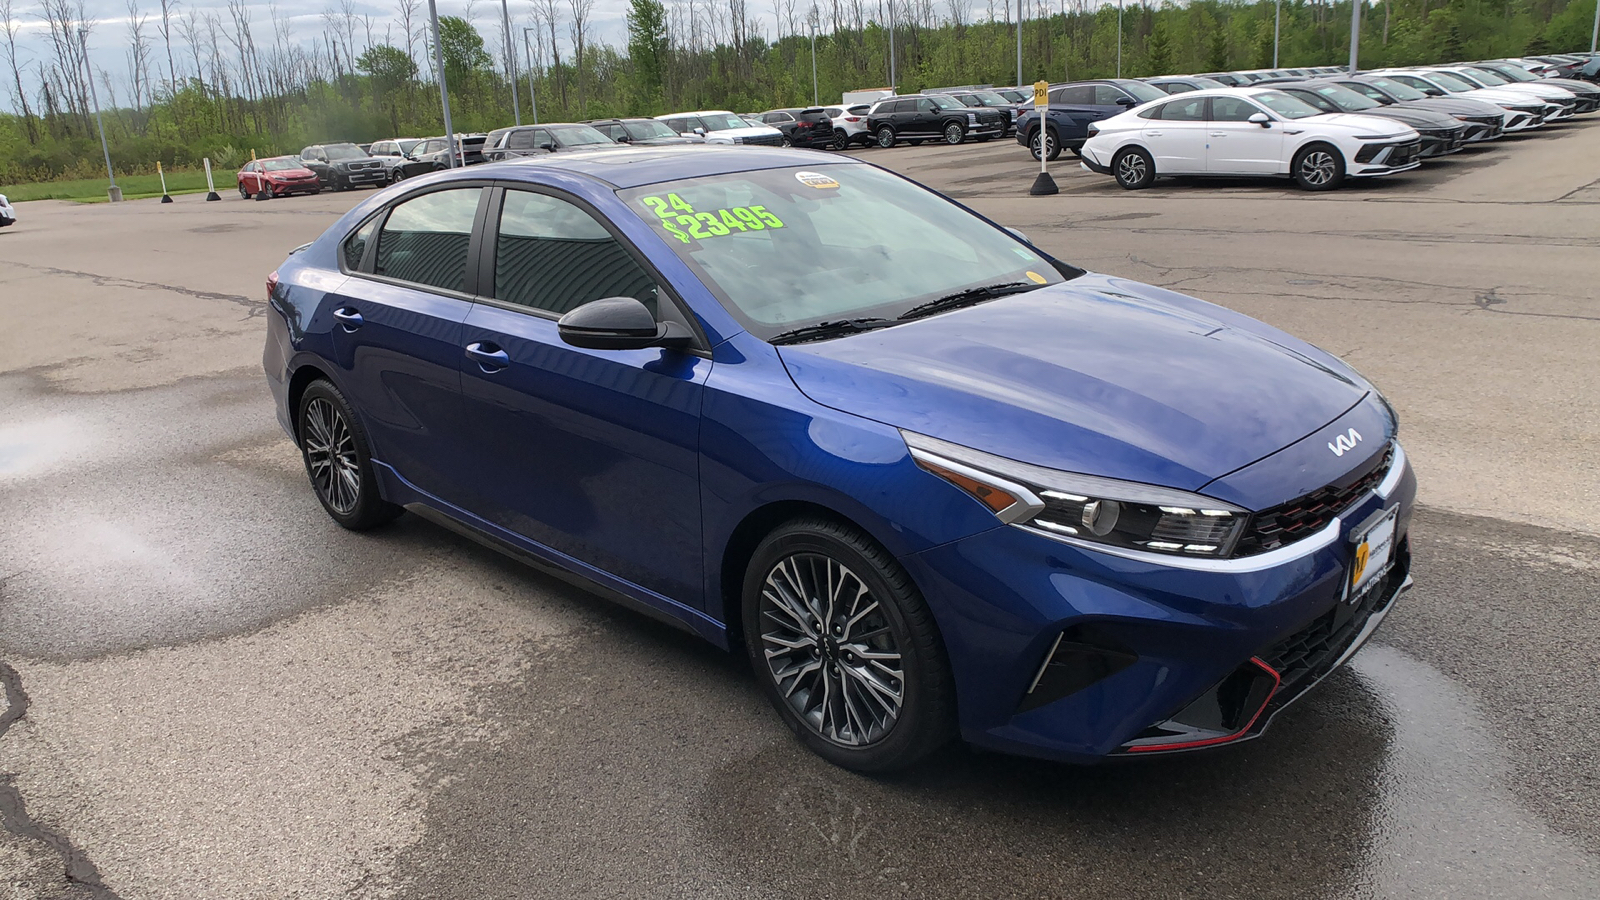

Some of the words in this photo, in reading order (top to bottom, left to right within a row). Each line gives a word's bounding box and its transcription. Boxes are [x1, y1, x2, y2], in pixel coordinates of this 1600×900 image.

[1035, 89, 1047, 97] PDI
[643, 192, 693, 218] 24
[661, 205, 784, 244] $23495
[1328, 427, 1363, 457] KIA
